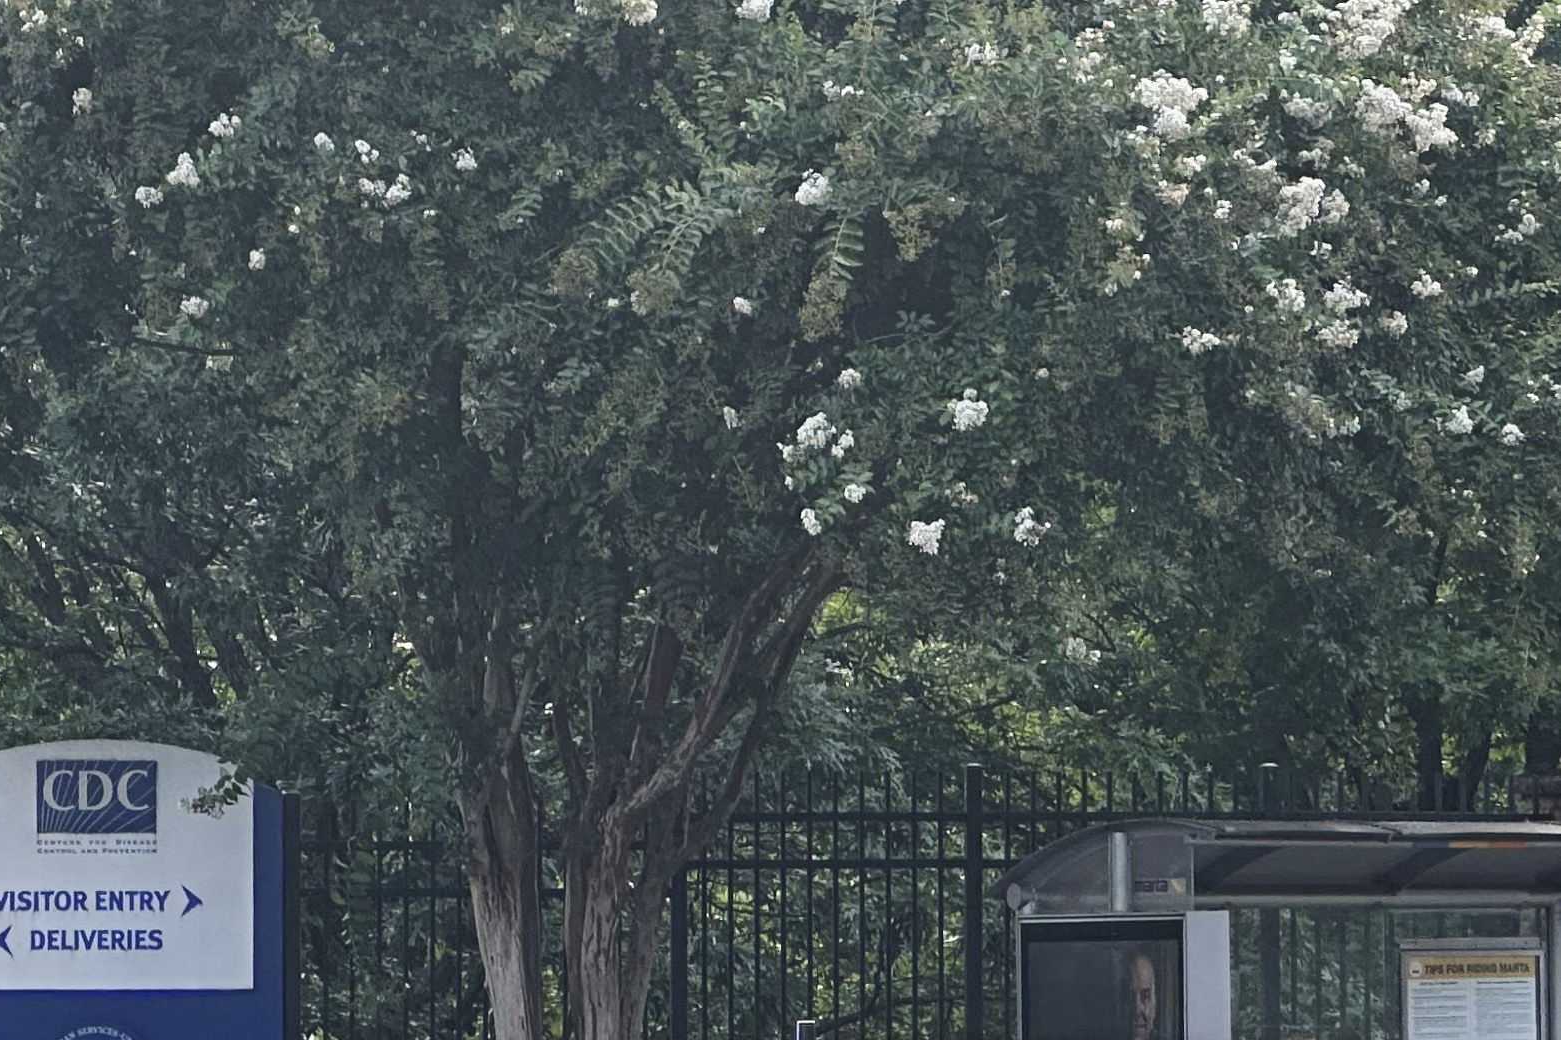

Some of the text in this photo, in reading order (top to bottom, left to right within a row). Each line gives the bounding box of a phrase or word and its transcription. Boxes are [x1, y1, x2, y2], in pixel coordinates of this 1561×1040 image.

[43, 769, 150, 811] CDC
[94, 889, 171, 912] ENTRY
[30, 928, 164, 951] DELIVERIES
[1424, 964, 1444, 975] TIPS
[1446, 963, 1465, 974] FOR
[77, 1026, 119, 1038] SERVICES
